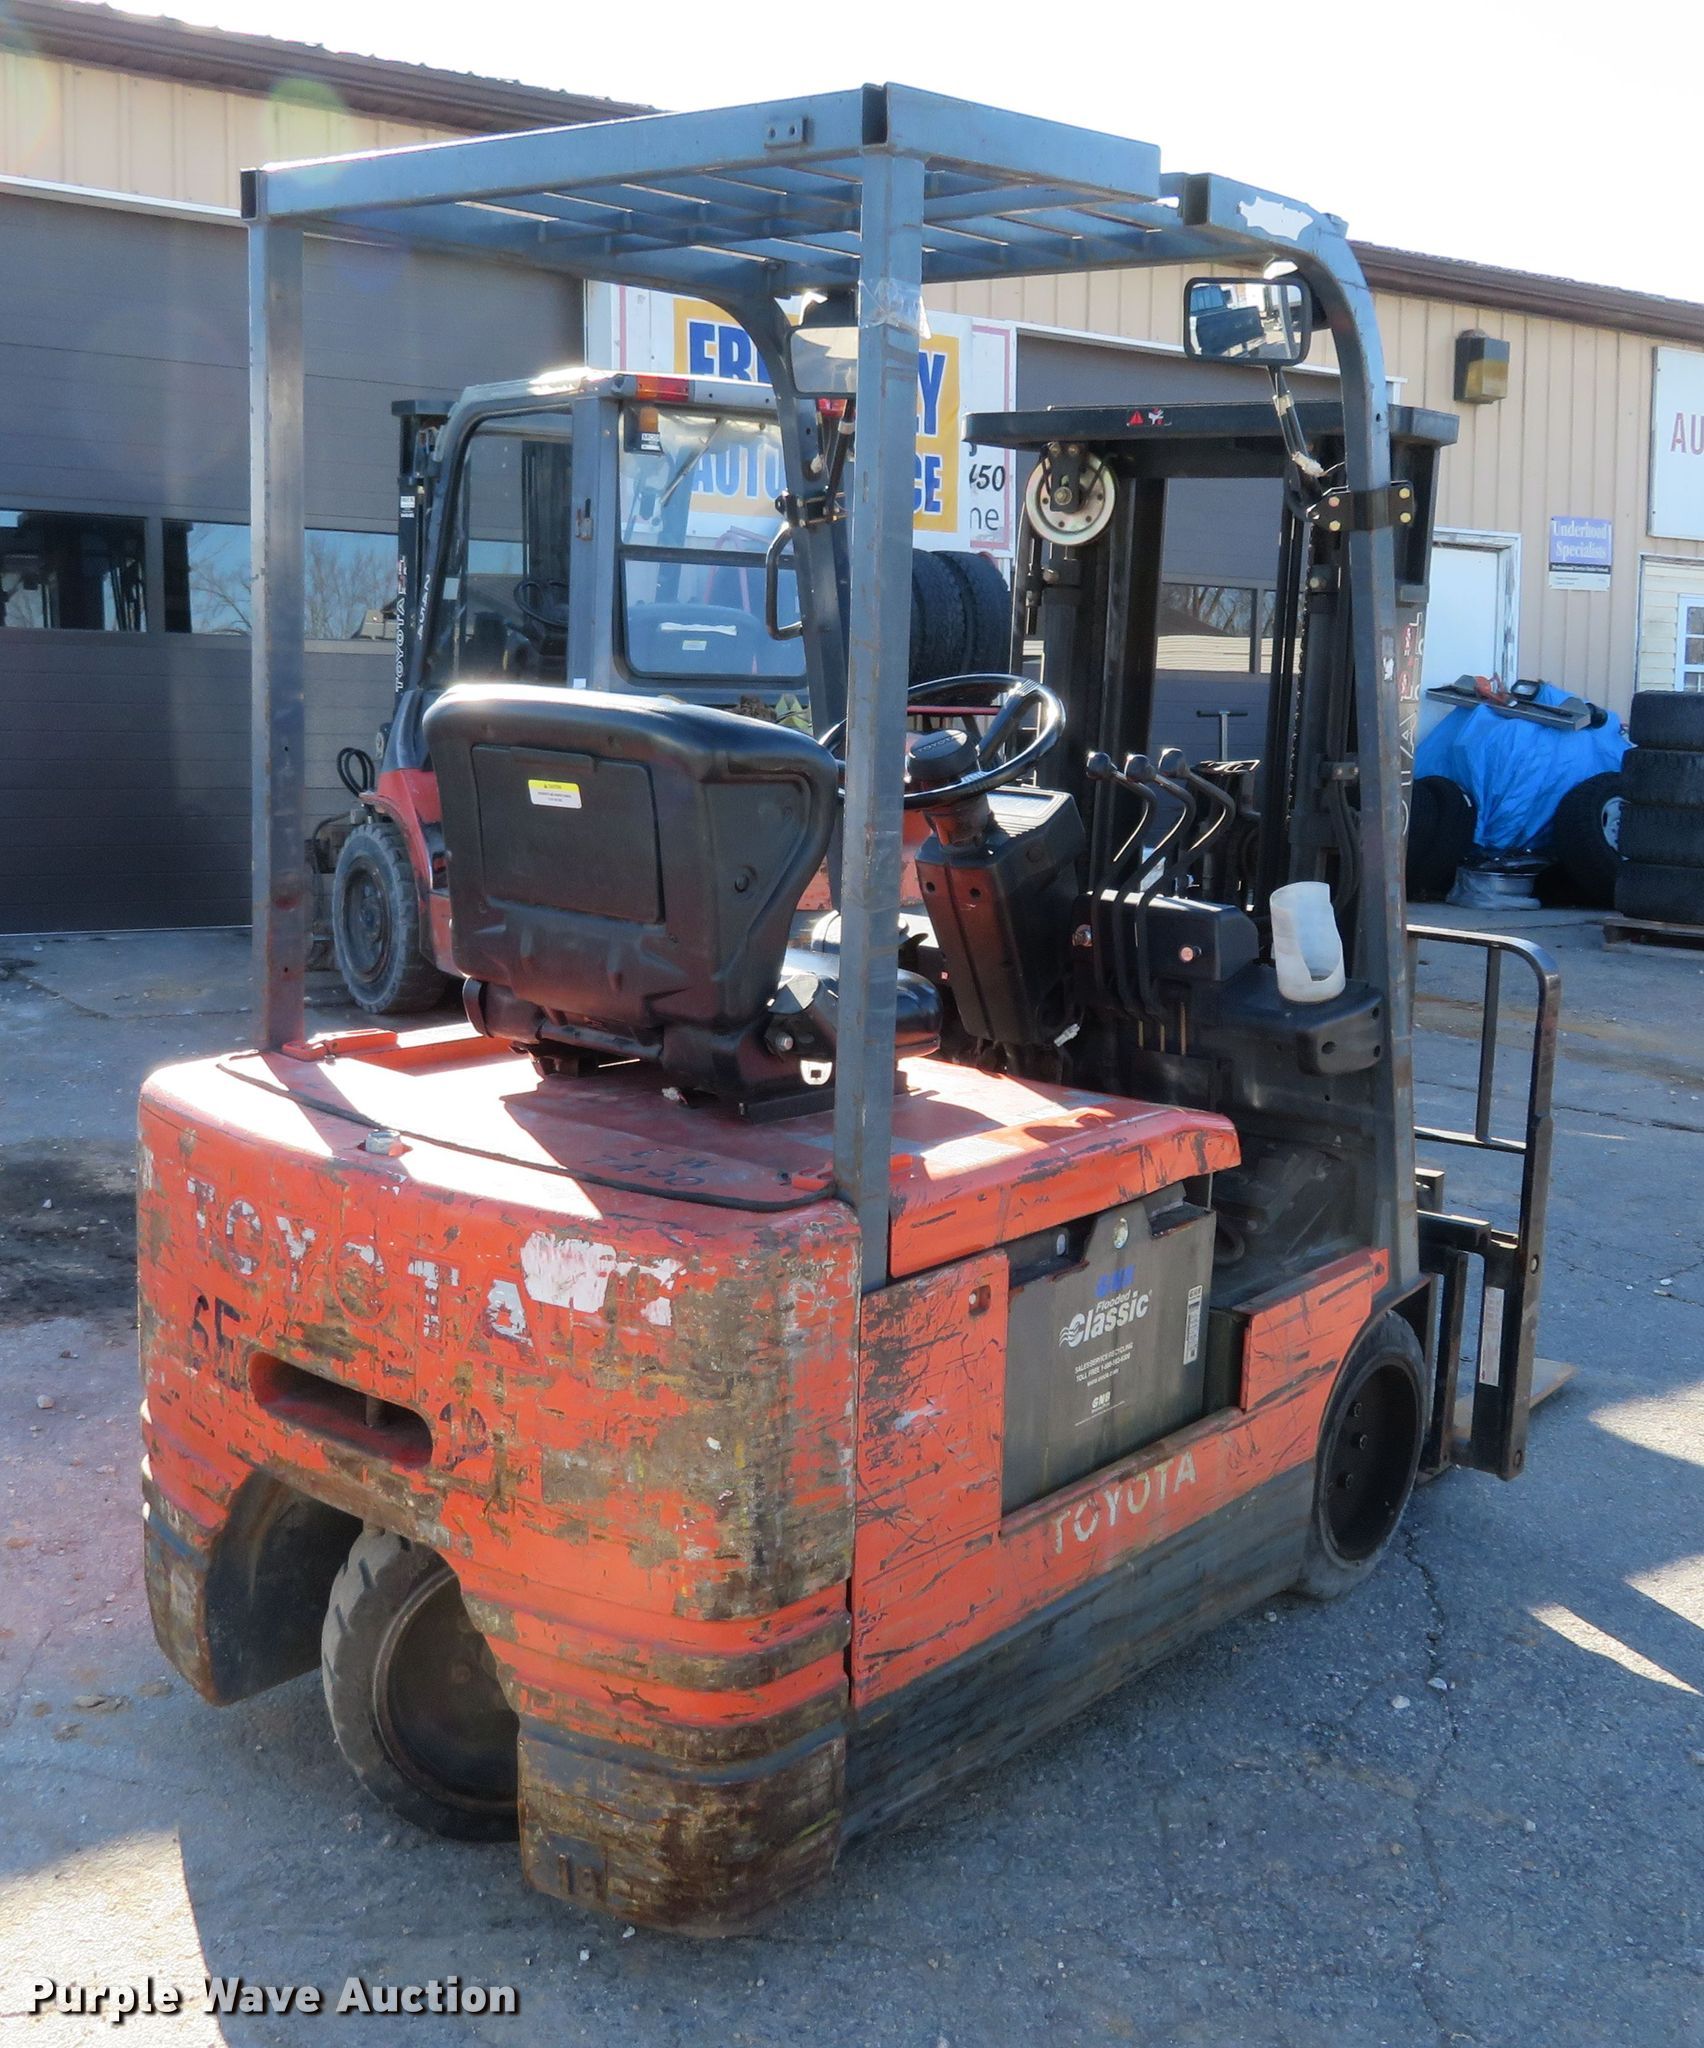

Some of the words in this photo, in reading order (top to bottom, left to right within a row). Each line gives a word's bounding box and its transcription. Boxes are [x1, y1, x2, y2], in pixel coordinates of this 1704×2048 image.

[396, 597, 406, 693] TOYOTA
[186, 1176, 538, 1366] TOYOTA
[1067, 1290, 1149, 1347] Classic
[1096, 1289, 1131, 1313] Flooded
[1053, 1451, 1196, 1555] TOYOTA
